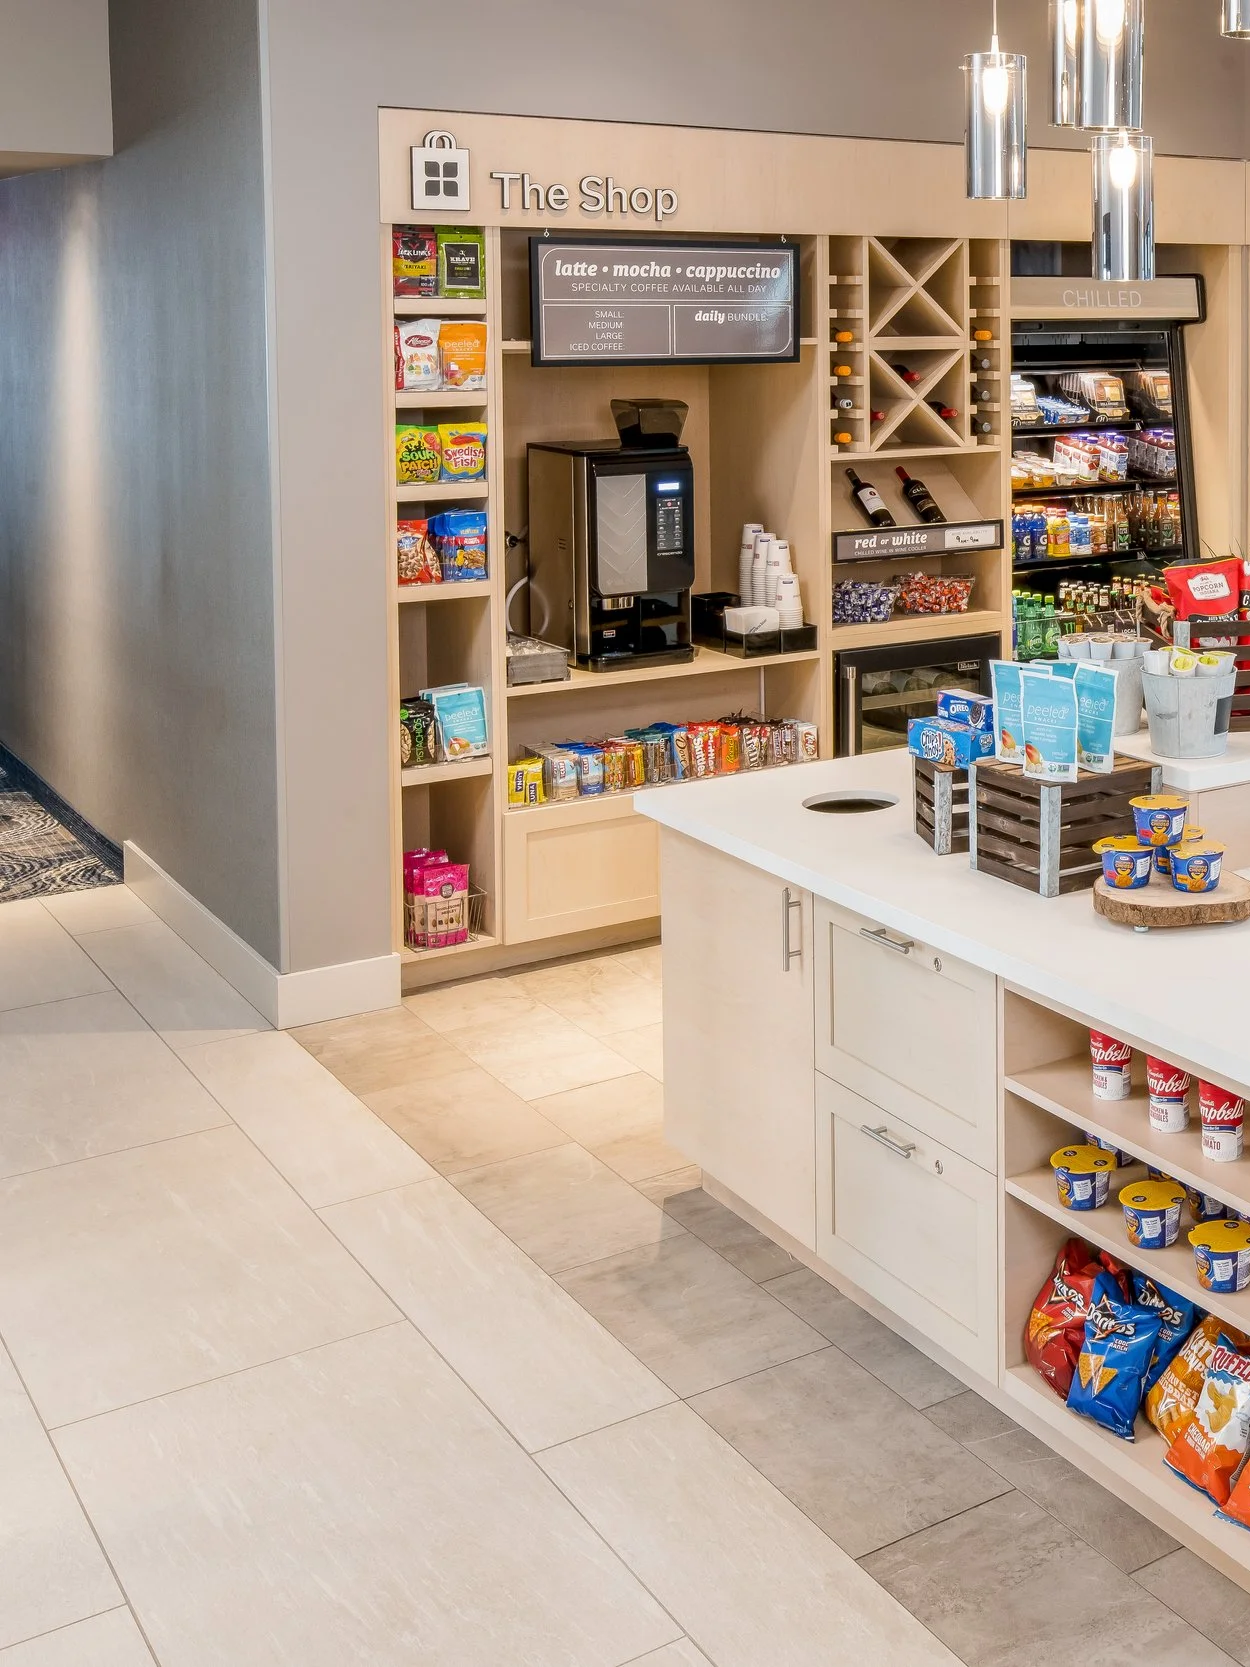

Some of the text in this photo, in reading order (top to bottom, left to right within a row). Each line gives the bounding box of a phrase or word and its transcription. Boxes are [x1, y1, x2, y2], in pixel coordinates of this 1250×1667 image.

[490, 172, 678, 221] The Shop
[555, 260, 781, 282] latte mocha cappuccino
[571, 282, 767, 293] SPECIALTY COFFEE AVAILABLE ALL DAY
[1062, 289, 1142, 308] CHILLED
[595, 310, 625, 319] SMALL:
[694, 310, 725, 324] daily
[588, 321, 625, 329] MEDIUM:
[595, 332, 625, 340] LARGE:
[569, 343, 625, 351] ICED COFFEE:
[402, 450, 435, 461] SOUR
[444, 446, 485, 462] Swedish
[400, 458, 438, 472] PATCH
[453, 457, 476, 468] Fish
[855, 531, 928, 549] red or white
[1192, 582, 1224, 592] POPCORN
[950, 704, 969, 714] OREO
[1080, 697, 1106, 711] eeled
[1027, 705, 1069, 720] peeled
[675, 735, 688, 767] Dove
[693, 737, 706, 777] Skittles
[1086, 1302, 1136, 1336] Doritos
[1109, 1342, 1129, 1352] RANCH
[1114, 1338, 1129, 1347] COOL
[1187, 1422, 1211, 1452] CHEDDAR
